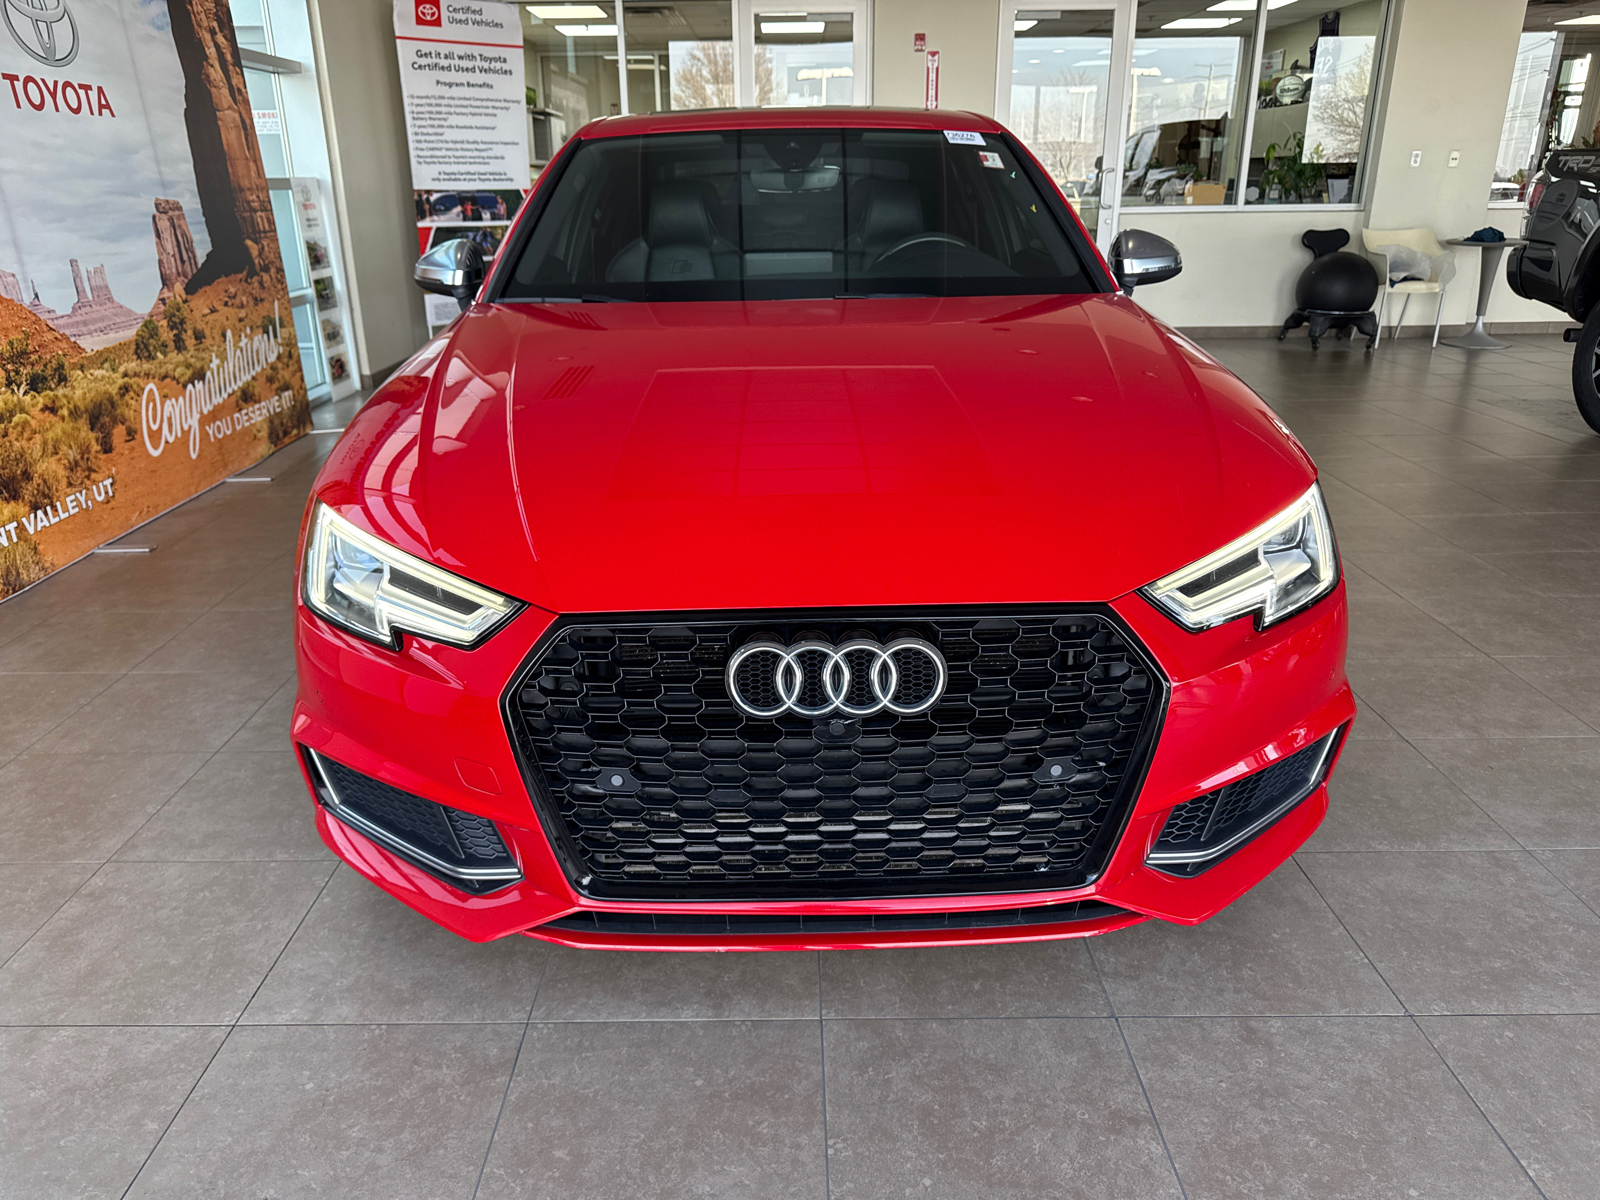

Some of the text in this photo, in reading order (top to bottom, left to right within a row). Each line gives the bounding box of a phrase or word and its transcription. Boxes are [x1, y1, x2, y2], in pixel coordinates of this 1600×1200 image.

[446, 4, 483, 16] Certified
[448, 16, 504, 29] Used Vehicles
[415, 49, 507, 65] Get it all with Toyota
[411, 62, 513, 76] Certified Used Vehicles
[436, 80, 494, 89] Program Benefits
[1, 72, 116, 118] TOYOTA
[1558, 156, 1596, 172] TRD
[142, 299, 283, 460] Congratulations!
[205, 390, 295, 442] YOU DESERVE IT!
[21, 489, 93, 535] VALLEY,
[92, 478, 113, 502] UT
